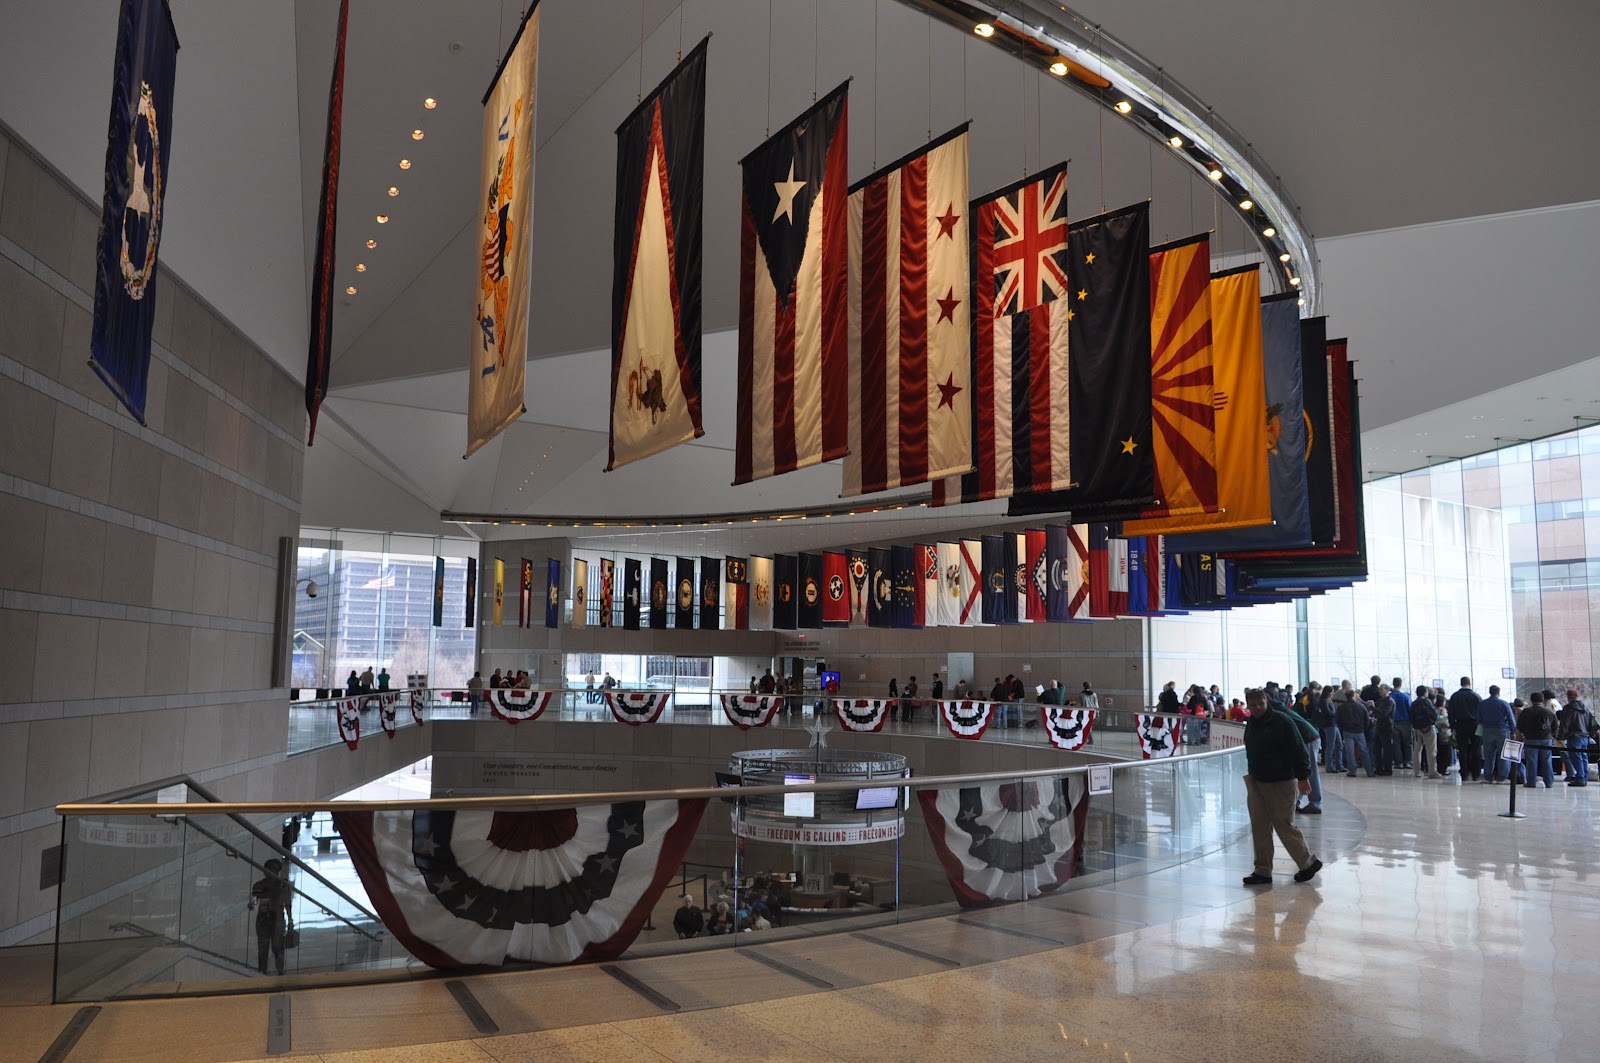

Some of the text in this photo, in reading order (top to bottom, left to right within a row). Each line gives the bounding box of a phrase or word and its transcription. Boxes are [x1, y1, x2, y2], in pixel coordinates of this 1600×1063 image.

[1130, 550, 1138, 571] 1848
[483, 762, 497, 770] One
[595, 764, 617, 773] destiny
[767, 829, 800, 840] FREEDOM
[803, 831, 811, 842] IS
[813, 831, 846, 843] CALLING
[858, 828, 886, 840] FREEDOM
